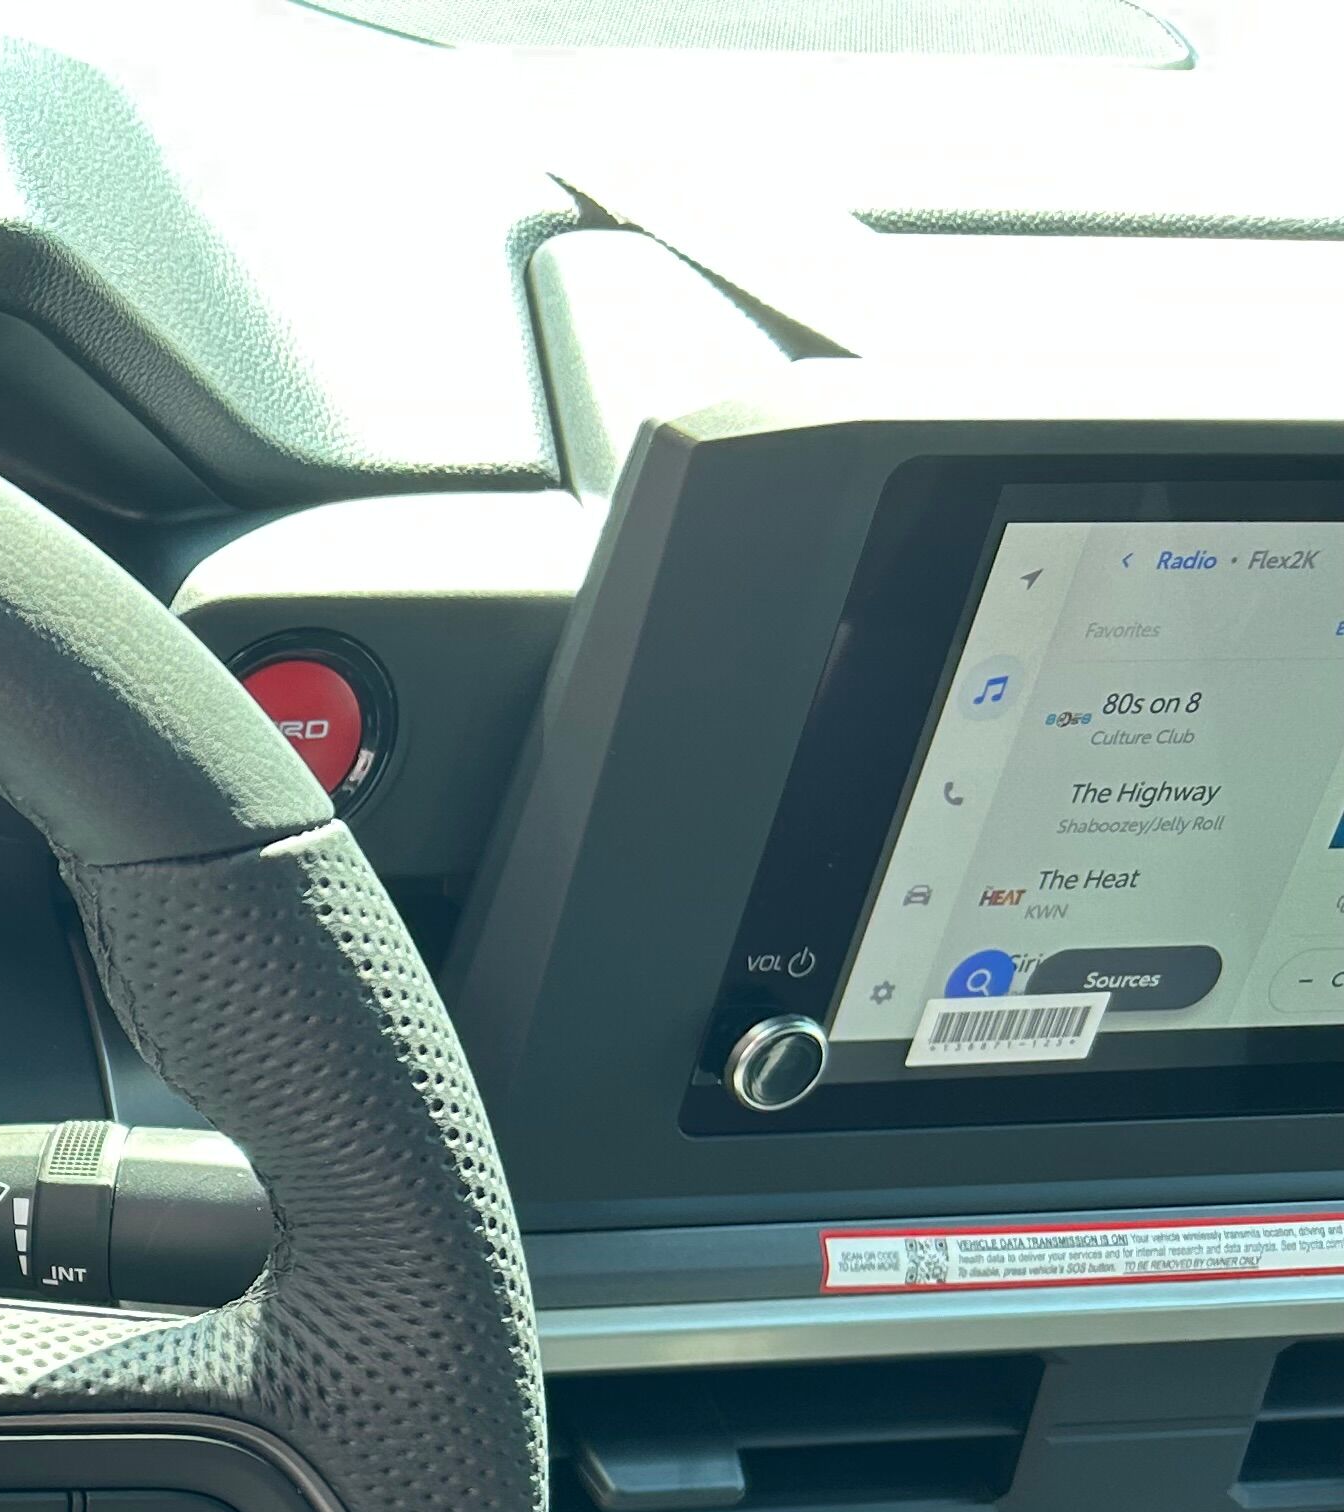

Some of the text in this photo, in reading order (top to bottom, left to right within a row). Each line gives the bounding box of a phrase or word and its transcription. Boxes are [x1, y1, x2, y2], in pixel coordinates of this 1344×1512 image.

[1156, 550, 1321, 570] Radio Flex2K
[1084, 621, 1161, 640] Favorites
[1102, 691, 1203, 715] 80s on 8
[278, 719, 329, 739] RD
[1090, 728, 1195, 746] Culture Club
[1070, 781, 1223, 810] The Highway
[1193, 815, 1226, 833] Roll
[1038, 868, 1141, 890] The Heat
[978, 888, 1027, 907] HEAT
[1023, 904, 1069, 919] KWN
[747, 955, 782, 972] VOL
[1083, 971, 1162, 990] Sources
